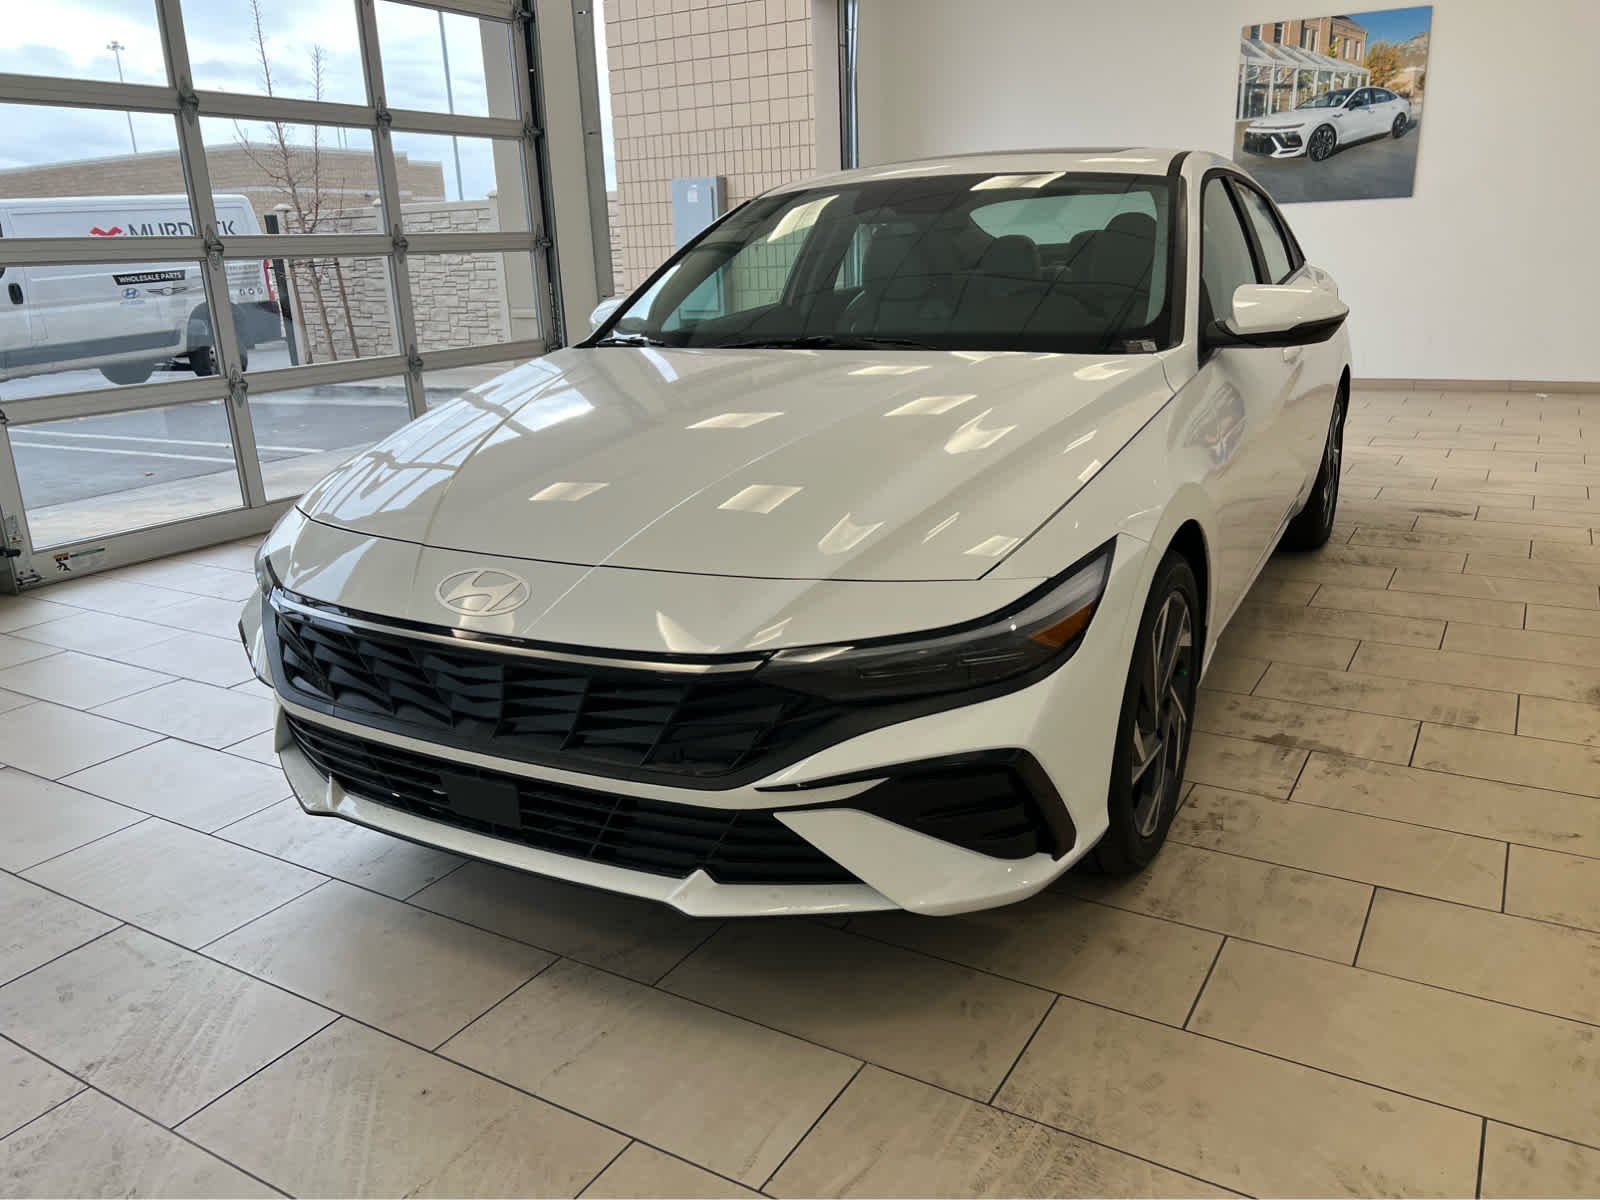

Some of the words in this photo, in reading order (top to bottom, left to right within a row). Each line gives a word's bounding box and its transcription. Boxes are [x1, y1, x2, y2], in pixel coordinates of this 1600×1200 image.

[127, 220, 236, 236] MURDK
[119, 273, 160, 282] WHOLESALE
[160, 272, 182, 281] PARTS
